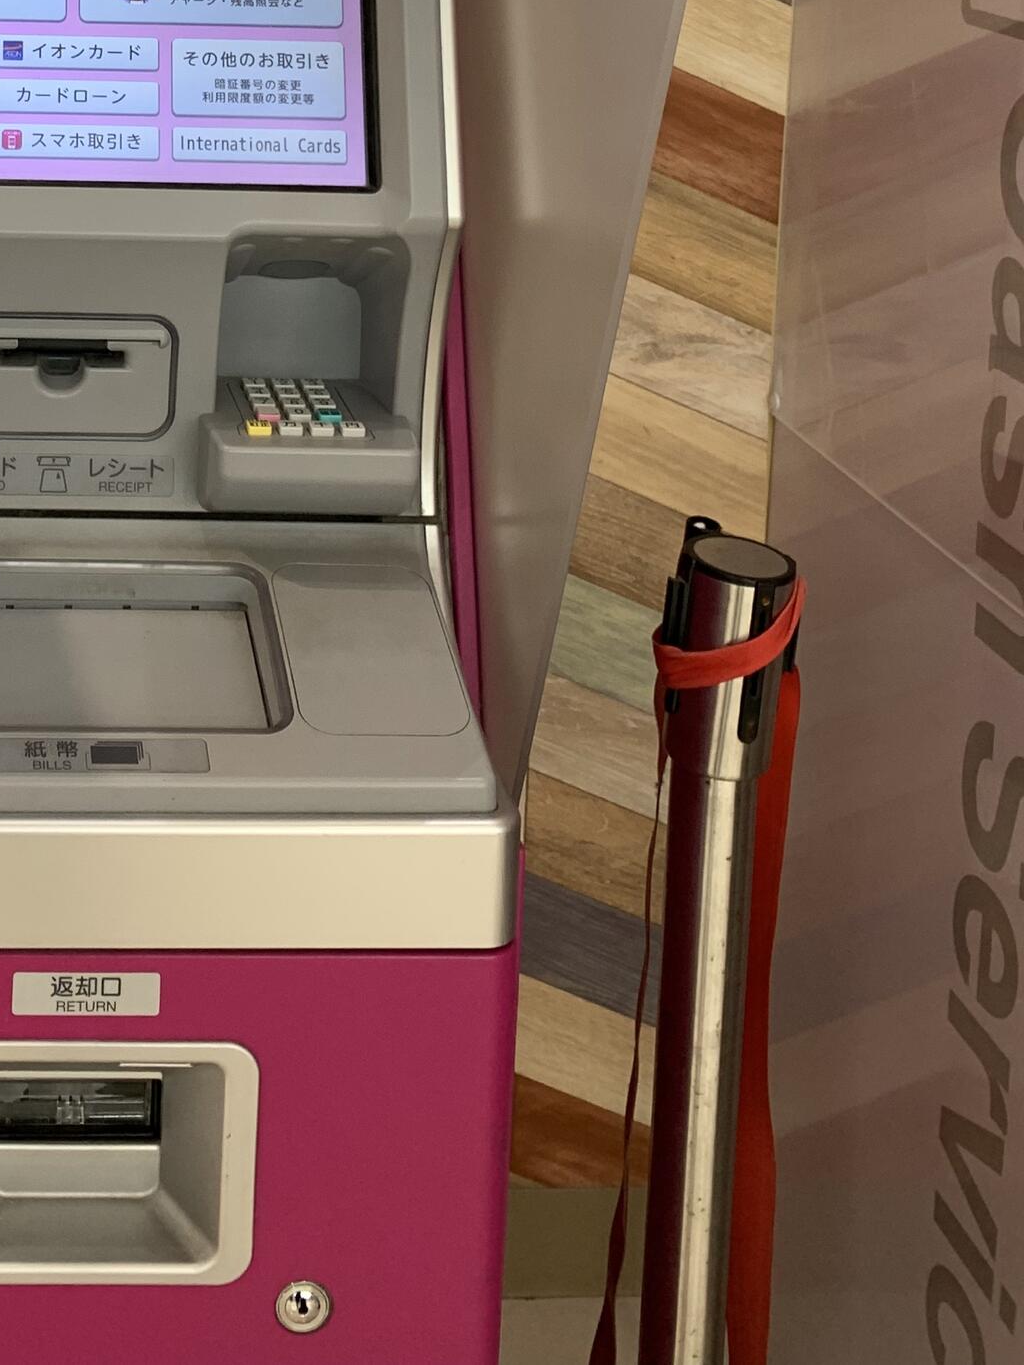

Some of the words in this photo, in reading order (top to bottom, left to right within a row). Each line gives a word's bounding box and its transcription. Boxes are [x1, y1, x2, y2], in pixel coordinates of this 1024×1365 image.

[31, 42, 142, 62] イオンカード
[182, 50, 331, 71] その他のお取引き
[214, 78, 302, 92] 暗証番号の変更
[16, 86, 127, 106] カードローン
[202, 91, 315, 105] 利用限度額の変更等
[31, 132, 142, 152] スマホ取引き
[179, 134, 289, 153] International
[298, 137, 342, 155] Cards
[89, 456, 165, 477] レシート
[98, 480, 153, 493] RECEIPT
[24, 740, 78, 759] 紙幣
[32, 760, 73, 770] BILLS
[50, 976, 122, 998] 返却口
[55, 1000, 117, 1013] RETURN
